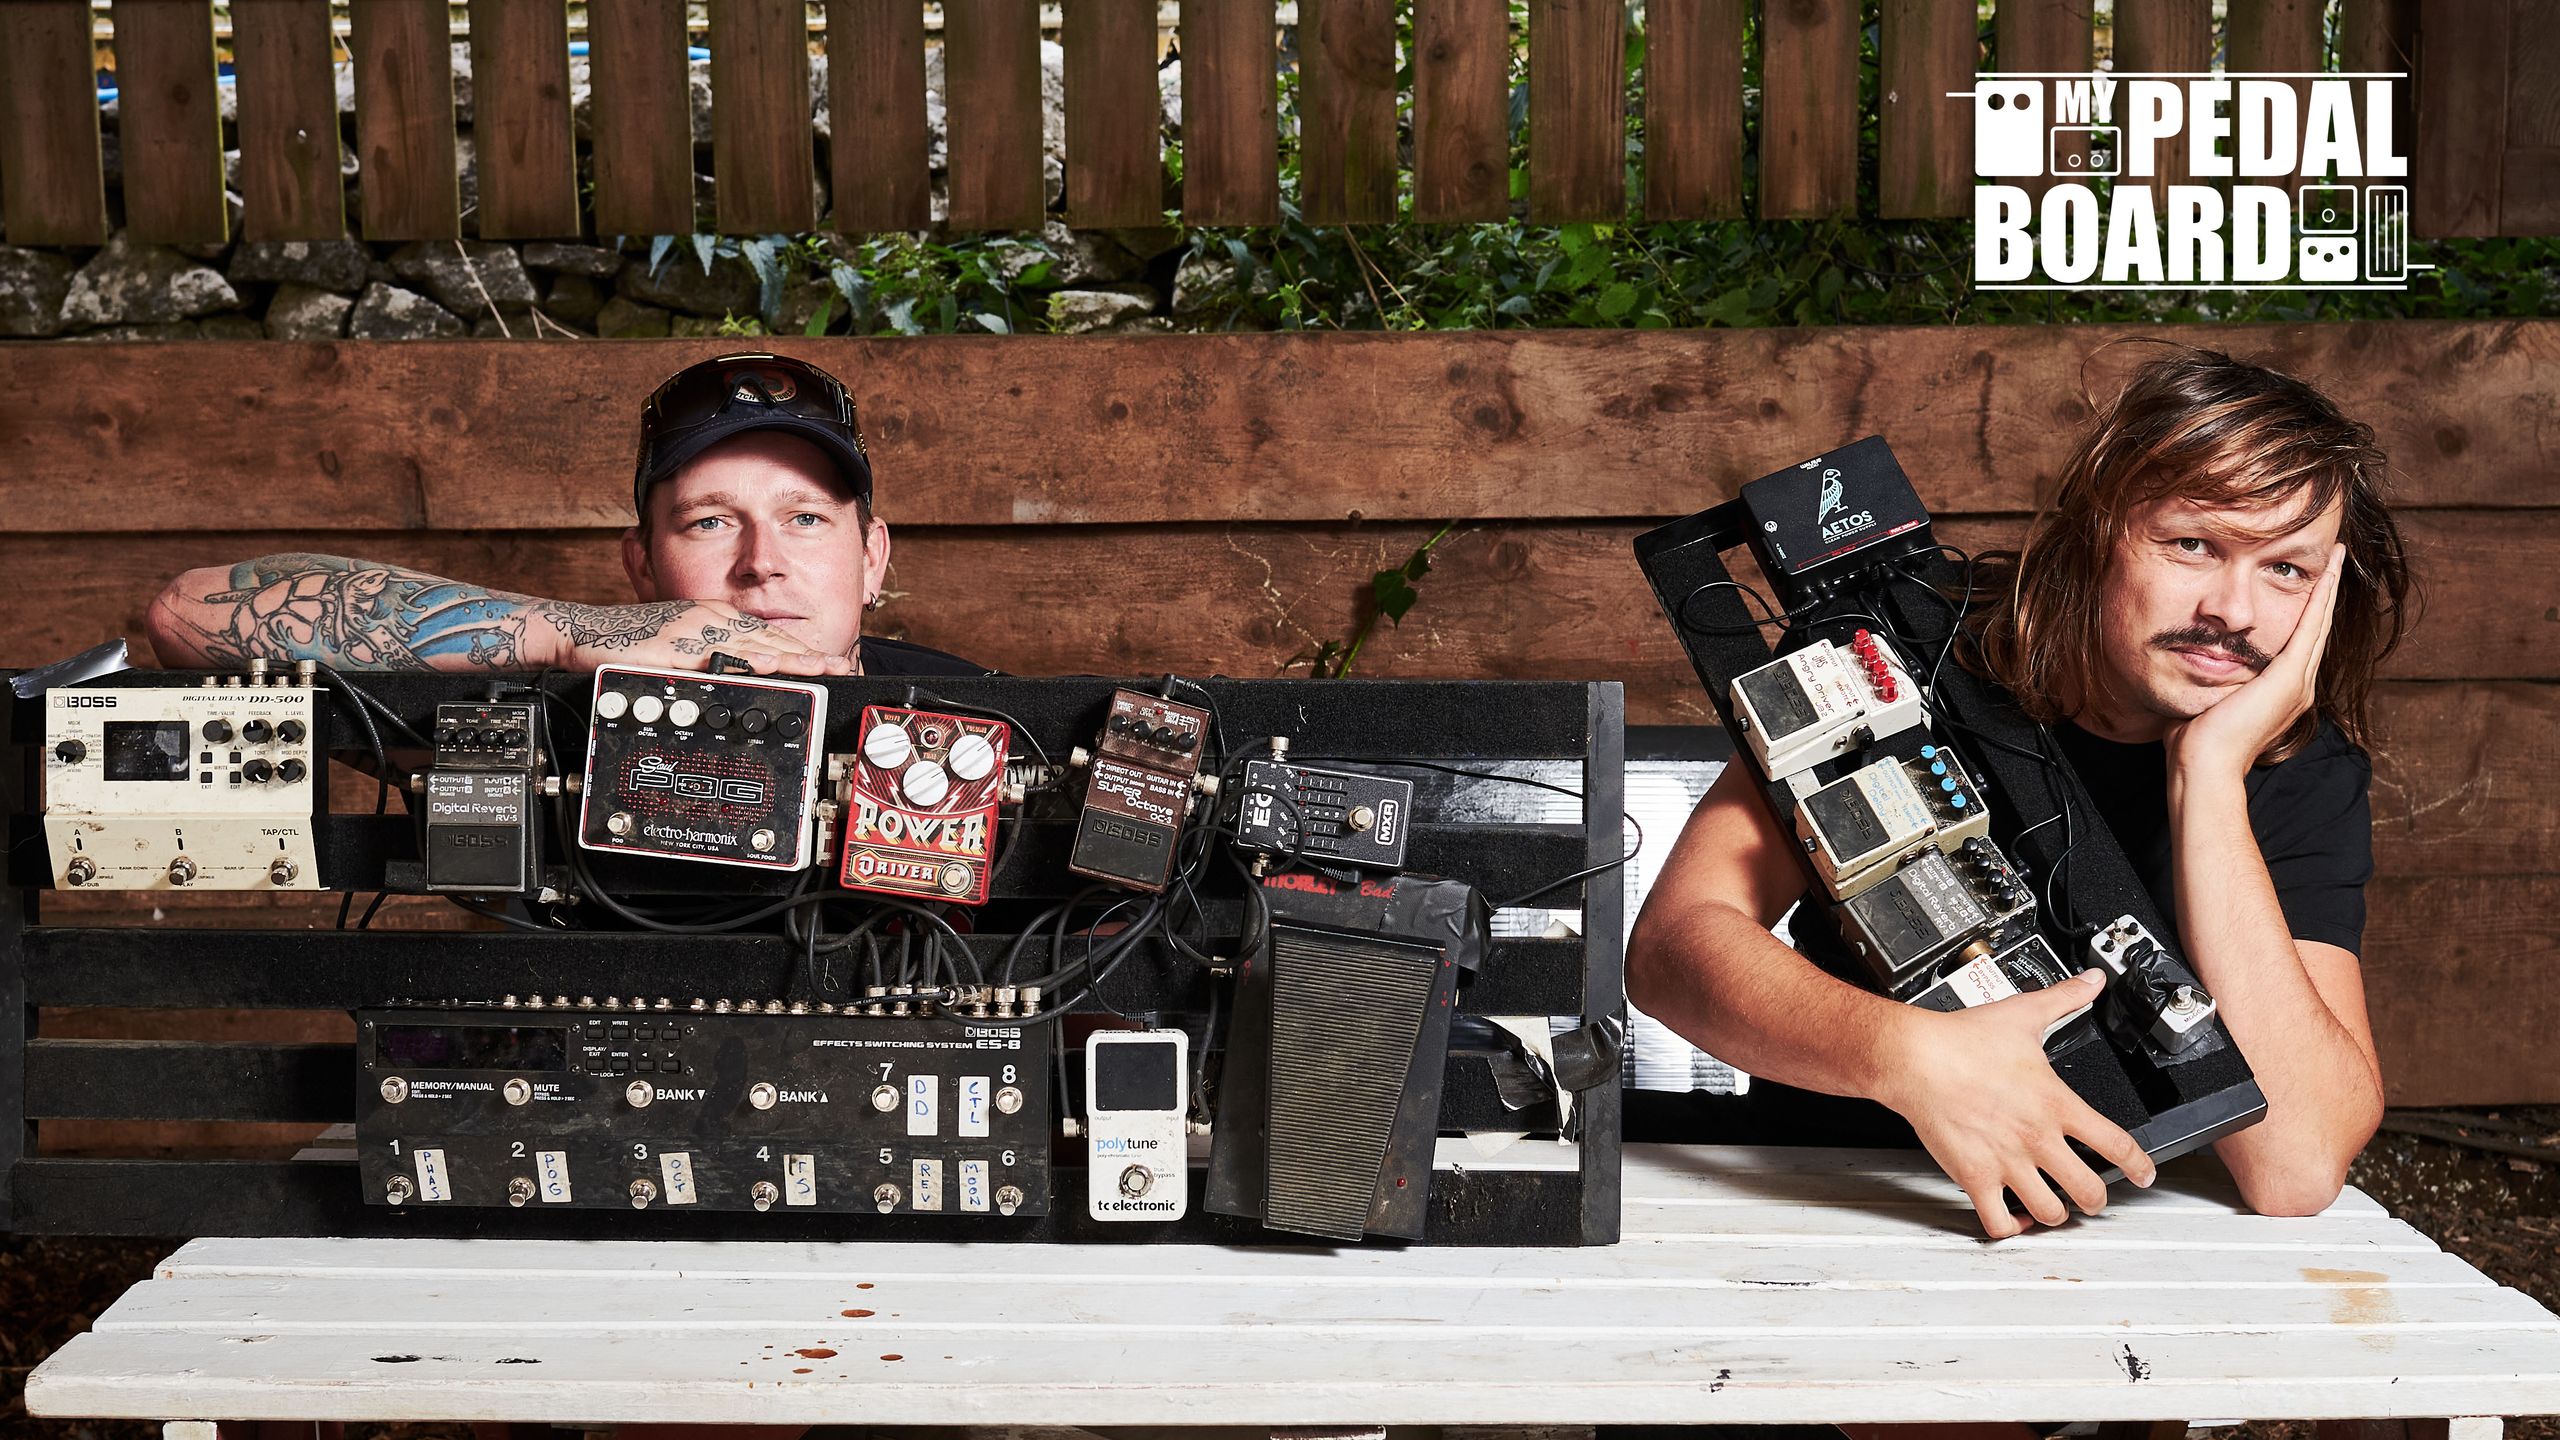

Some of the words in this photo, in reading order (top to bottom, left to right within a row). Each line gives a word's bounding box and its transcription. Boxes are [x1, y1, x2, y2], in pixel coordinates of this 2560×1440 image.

[1822, 510, 1873, 539] AETOS
[1797, 653, 1817, 683] Angry
[1814, 683, 1835, 713] Driver
[67, 696, 117, 708] BOSS
[249, 695, 305, 704] DD-500
[639, 756, 679, 773] Soul
[1104, 773, 1129, 784] OUTPUT
[1150, 784, 1167, 794] BASS
[1106, 764, 1129, 775] DIRECT
[1129, 770, 1143, 778] OUT
[1146, 774, 1169, 785] GUITAR
[1169, 780, 1177, 788] IN
[629, 768, 764, 804] POG
[1097, 780, 1142, 799] SUPER
[1868, 772, 1891, 801] Digital
[433, 803, 470, 815] Digital
[472, 803, 518, 814] Reverb
[1126, 797, 1174, 816] Octave
[1868, 789, 1885, 817] Delay
[495, 814, 518, 822] RV-5
[854, 791, 986, 854] POWER
[1150, 812, 1172, 824] OC-3
[1381, 804, 1394, 841] MXR
[643, 824, 739, 846] electro-harmonix
[676, 841, 691, 849] YORK
[858, 855, 934, 880] DRIVER
[1360, 880, 1396, 899] Bad
[1907, 868, 1933, 900] Digital
[1928, 896, 1956, 931] Reverb
[1978, 969, 1996, 990] BYPASS
[1986, 964, 2004, 986] OUTPUT
[1968, 970, 1995, 1004] Chro
[976, 1028, 1021, 1038] BOSS
[813, 1040, 863, 1048] EFFECTS
[864, 1040, 925, 1049] SWITCHING
[926, 1041, 973, 1049] SYSTEM
[975, 1039, 1021, 1050] ES-8
[879, 1063, 893, 1082] 7
[1002, 1064, 1016, 1084] 8
[411, 1081, 495, 1091] MEMORY/MANUAL
[534, 1084, 560, 1092] MUTE
[656, 1089, 693, 1101] BANK
[779, 1091, 817, 1103] BANK
[389, 1139, 401, 1155] 1
[511, 1142, 526, 1158] 2
[633, 1144, 648, 1160] 3
[1097, 1137, 1158, 1152] polytune
[756, 1146, 770, 1162] 4
[879, 1148, 893, 1165] 5
[1001, 1150, 1016, 1167] 6
[1098, 1200, 1110, 1211] tc
[1112, 1200, 1175, 1211] electronic
